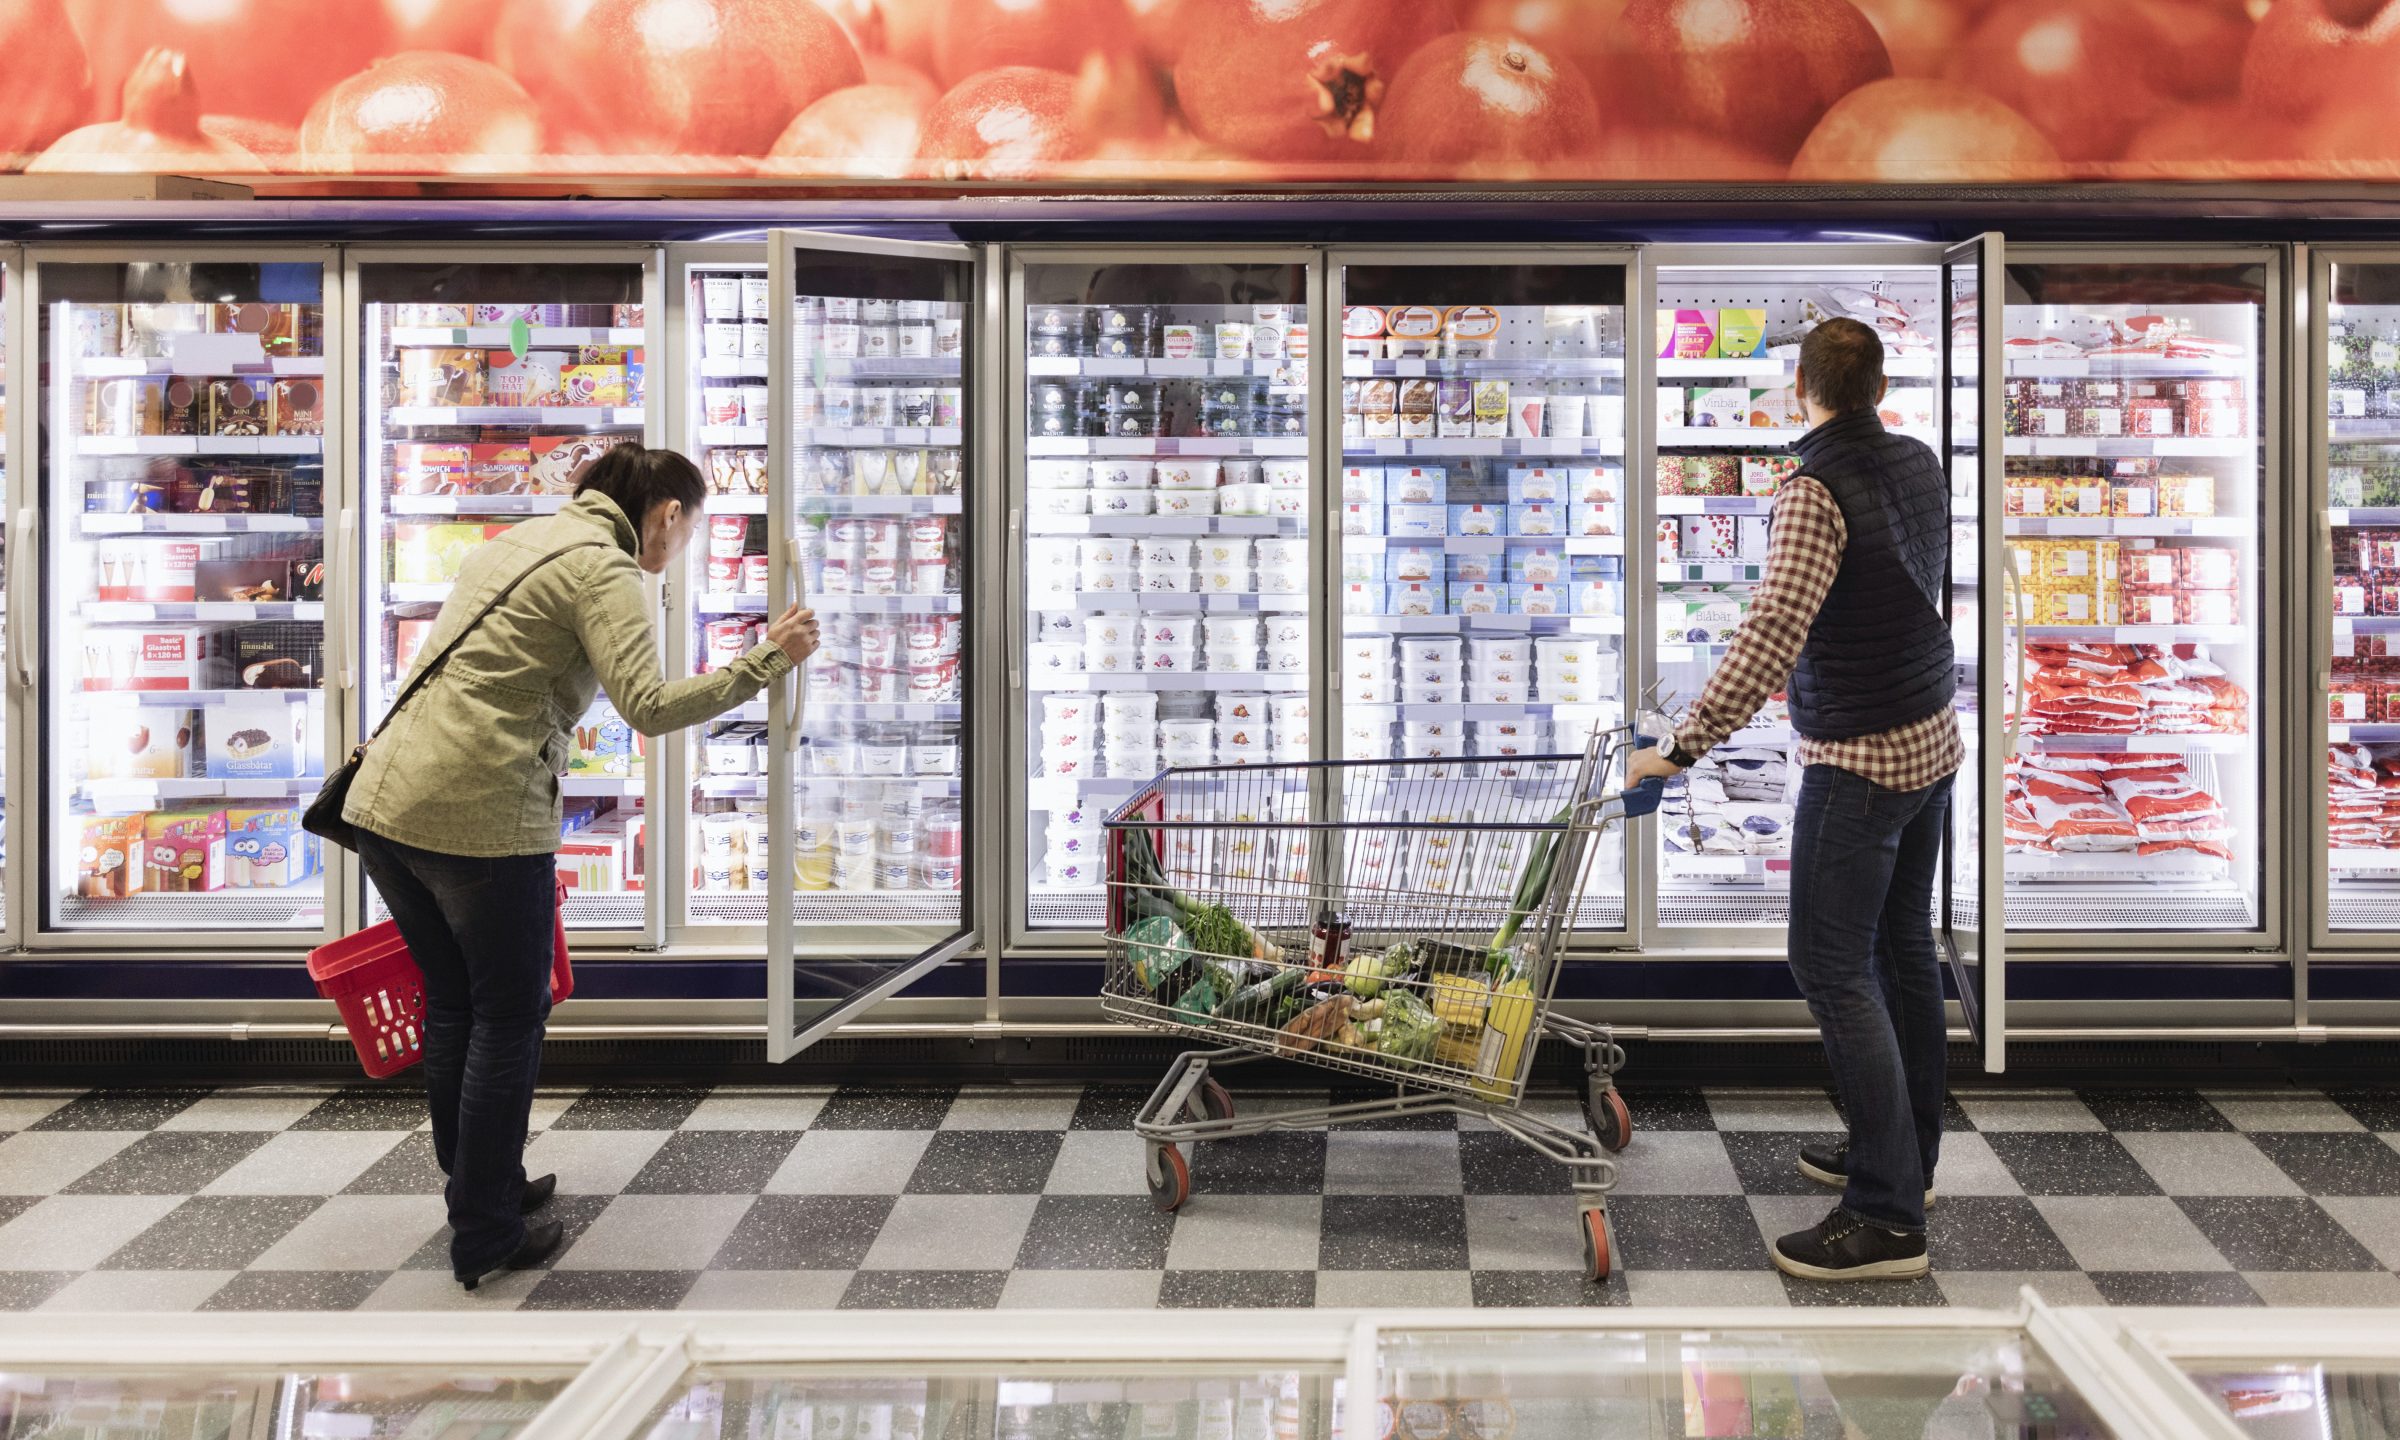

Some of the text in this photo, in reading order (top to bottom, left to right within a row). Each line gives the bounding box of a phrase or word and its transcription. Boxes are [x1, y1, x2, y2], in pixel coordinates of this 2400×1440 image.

[500, 375, 525, 383] TOP
[1703, 397, 1739, 408] Vinbär
[293, 409, 312, 418] MINI
[482, 463, 525, 473] SANDWICH
[1696, 610, 1732, 621] Blåbär
[226, 759, 273, 770] Glassbåtar
